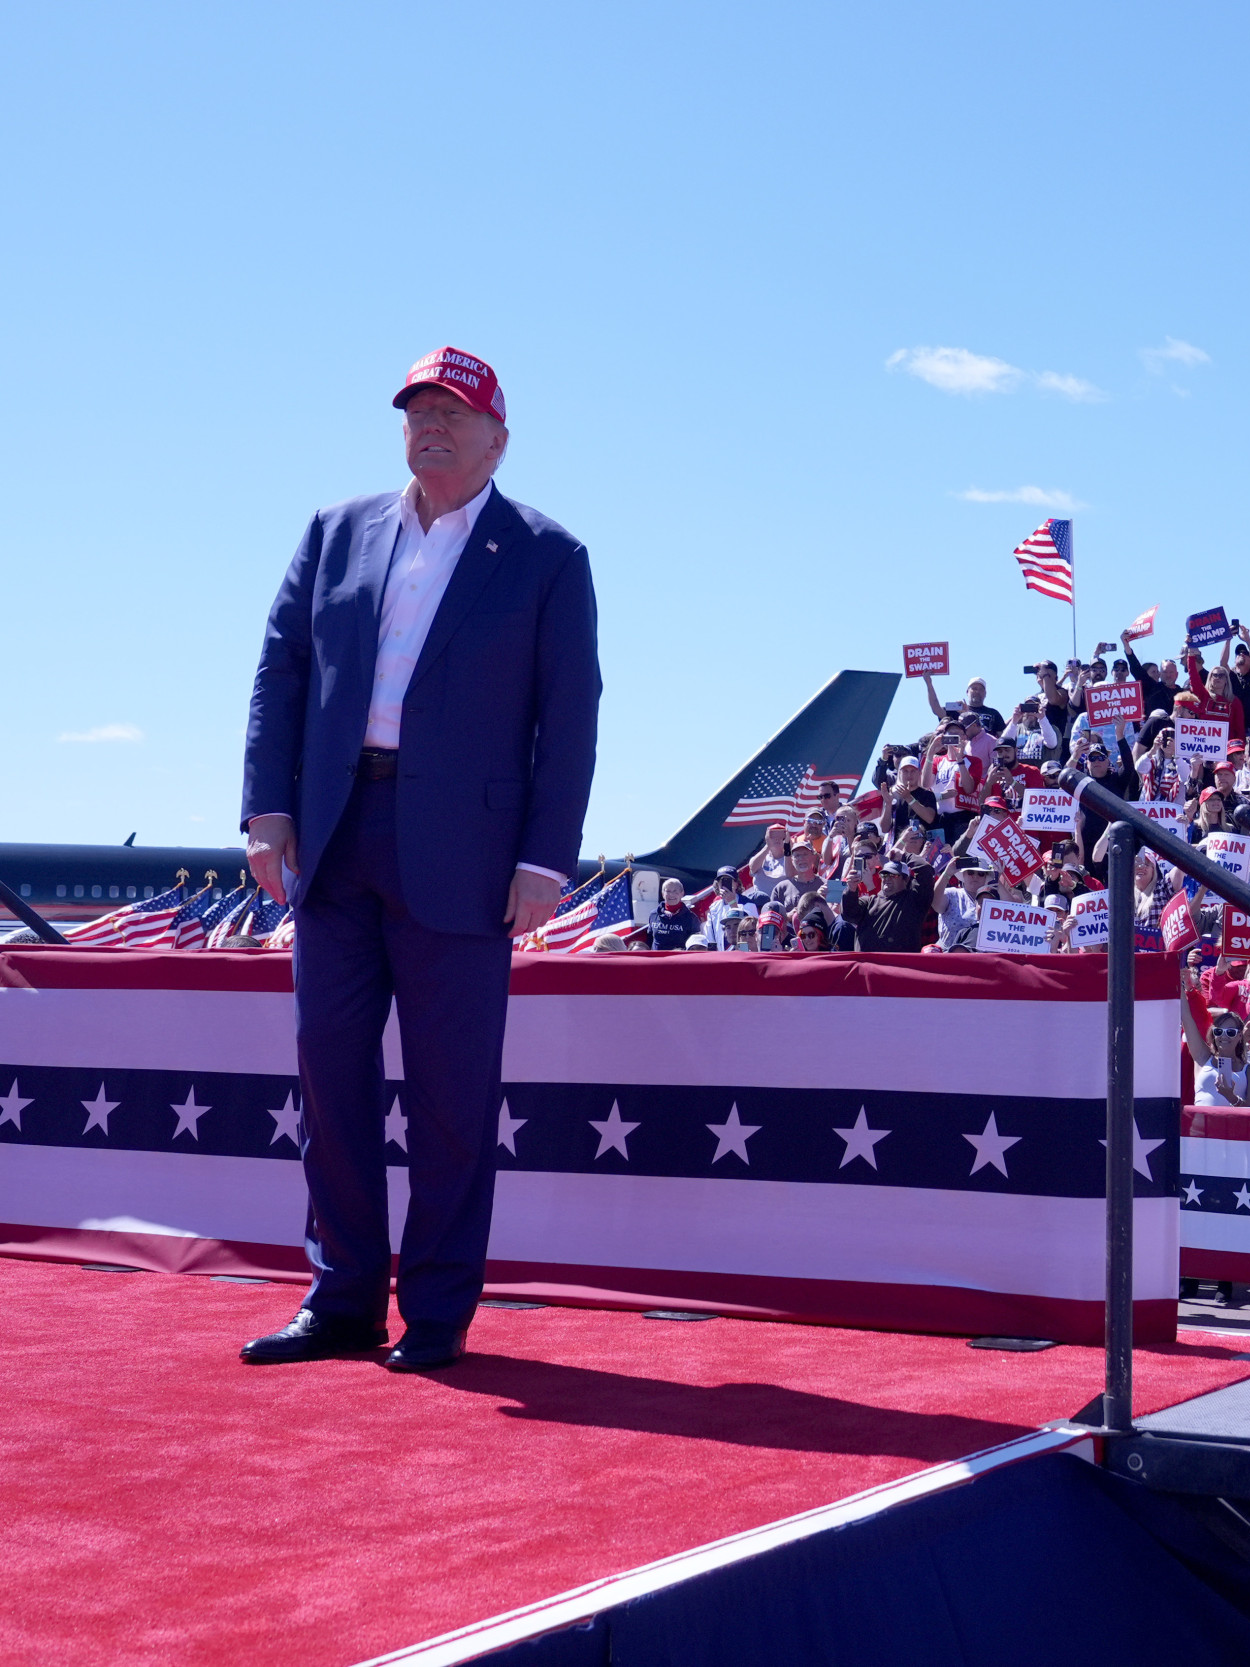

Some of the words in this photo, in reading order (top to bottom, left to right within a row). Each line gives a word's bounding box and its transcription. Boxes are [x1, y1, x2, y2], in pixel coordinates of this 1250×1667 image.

[410, 353, 437, 374] MAKE
[436, 351, 488, 377] AMERICA
[411, 366, 443, 383] GREAT
[443, 367, 480, 390] AGAIN
[1189, 612, 1222, 630] DRAIN
[1191, 627, 1226, 643] SWAMP
[907, 646, 944, 659] DRAIN
[908, 661, 944, 673] SWAMP
[1091, 687, 1136, 703] DRAIN
[1093, 705, 1137, 720] SWAMP
[1181, 725, 1222, 737] DRAIN
[1180, 743, 1221, 754] SWAMP
[1029, 795, 1073, 806] DRAIN
[1027, 813, 1070, 823] SWAMP
[1001, 824, 1038, 868] DRAIN
[1007, 845, 1019, 860] THE
[1208, 839, 1246, 854] DRAIN
[988, 837, 1022, 878] SWAMP
[1076, 898, 1108, 915] DRA
[990, 907, 1047, 926] DRAIN
[651, 921, 668, 930] TEAM
[669, 923, 684, 932] USA
[1008, 924, 1025, 932] THE
[1078, 923, 1108, 937] SWA
[986, 930, 1044, 947] SWAMP
